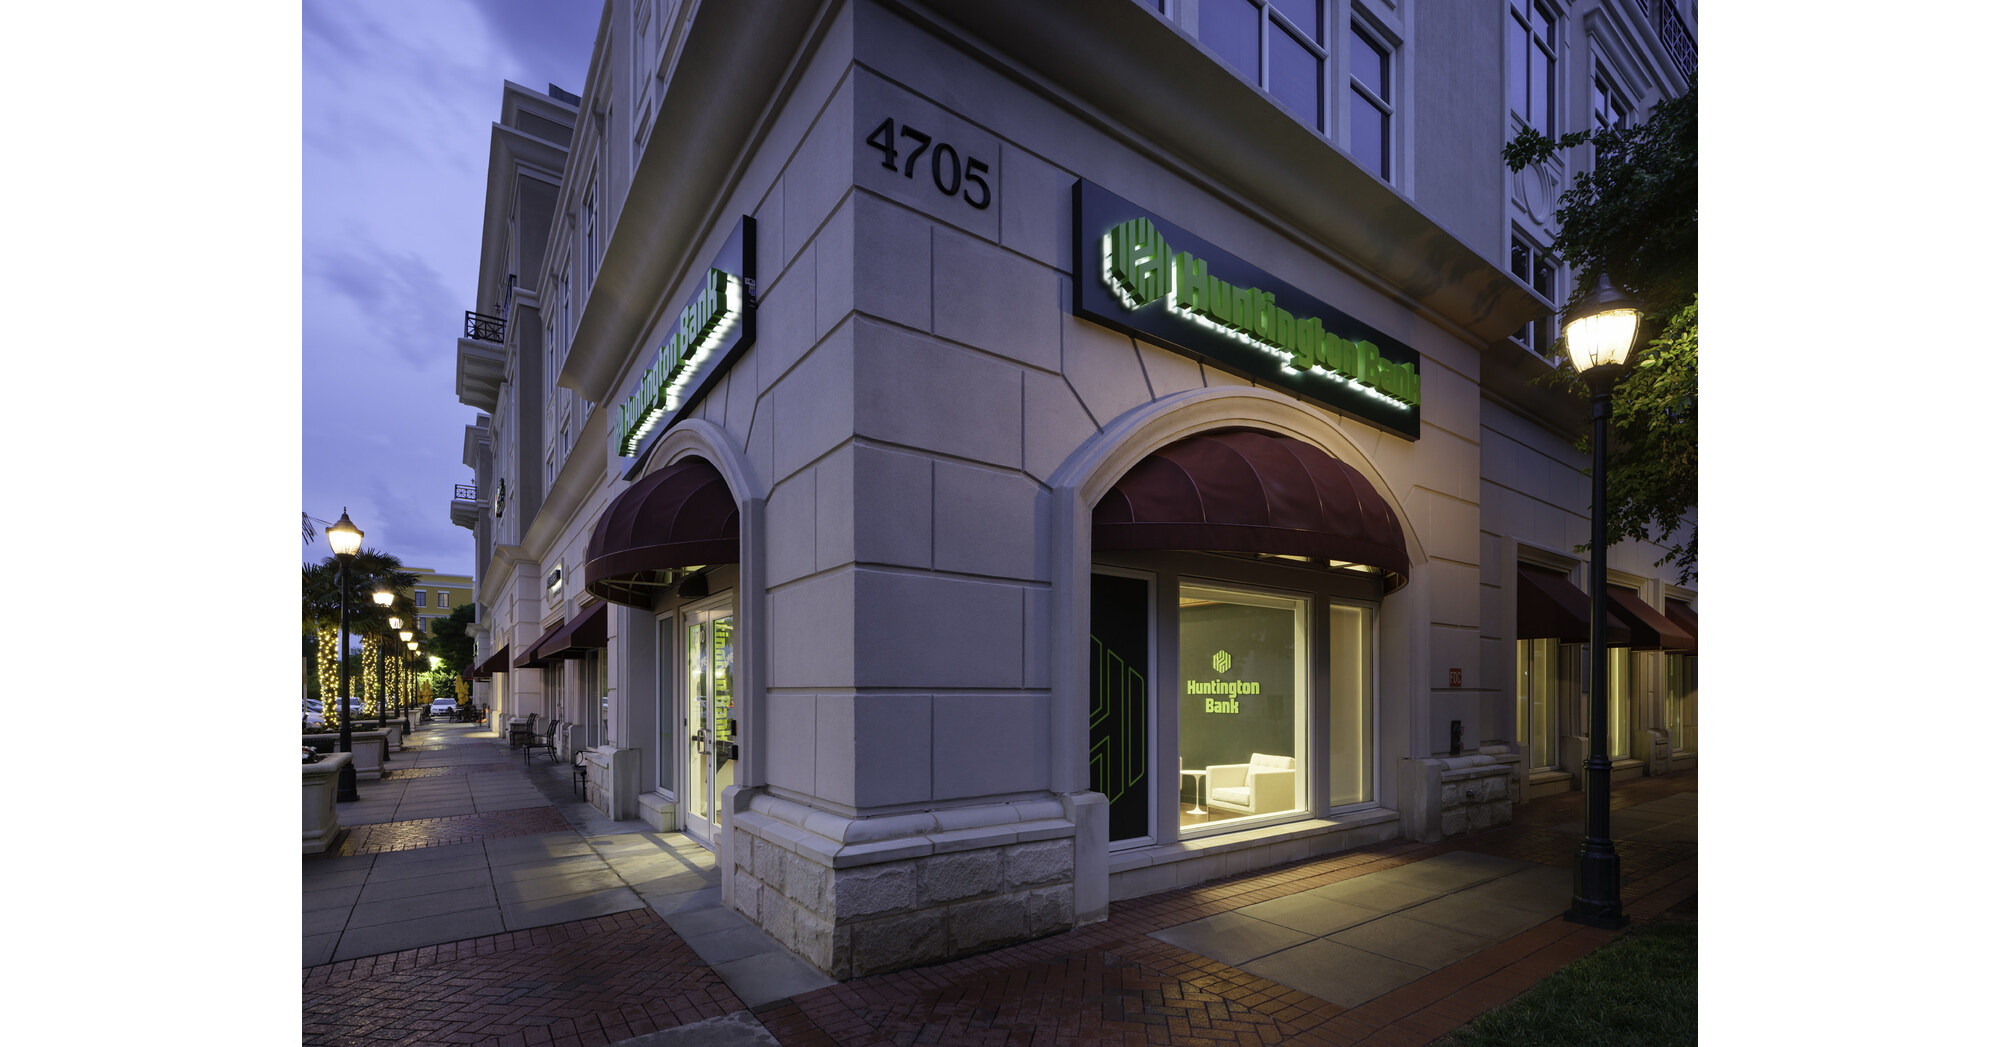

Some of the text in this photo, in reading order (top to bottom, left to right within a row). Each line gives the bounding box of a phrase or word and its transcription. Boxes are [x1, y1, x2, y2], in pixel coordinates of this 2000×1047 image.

[866, 117, 991, 210] 4705
[624, 267, 728, 437] Huntington Bank
[1176, 250, 1421, 408] Huntington Bank
[1187, 679, 1260, 699] Huntington
[1205, 698, 1239, 714] Bank
